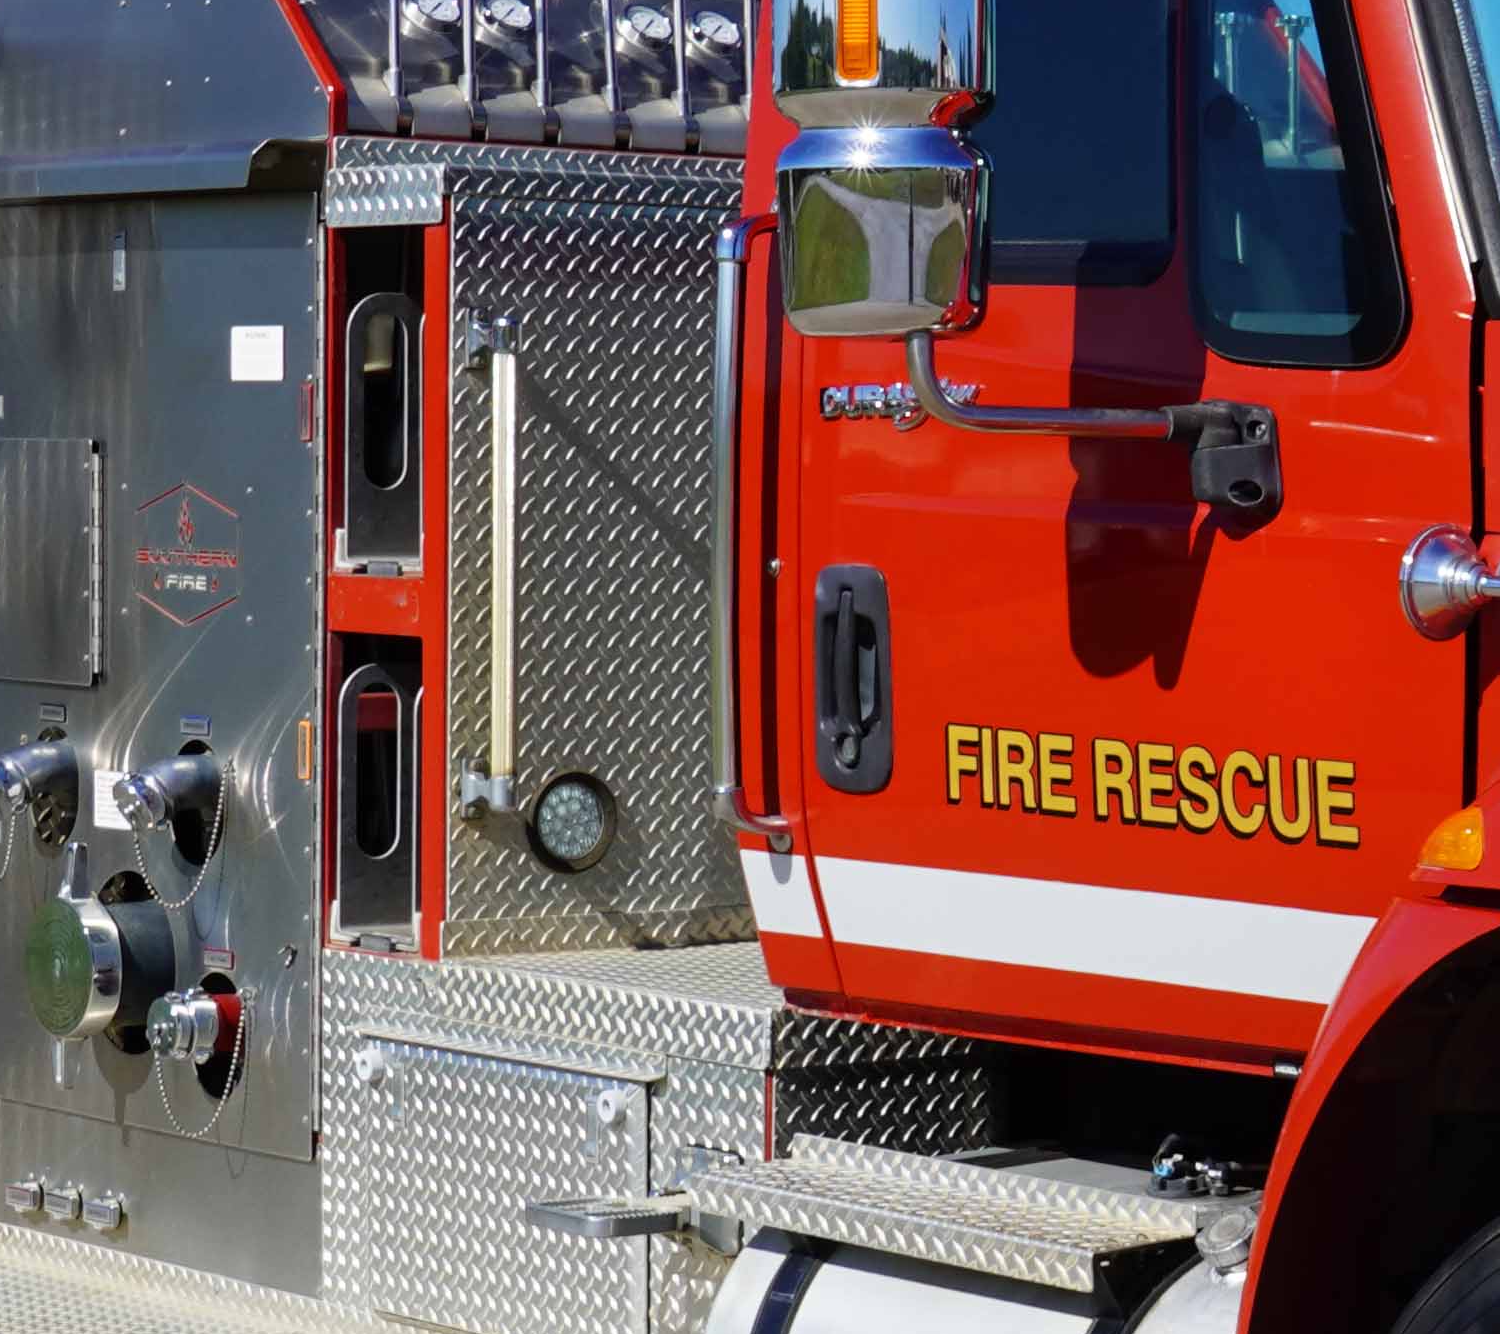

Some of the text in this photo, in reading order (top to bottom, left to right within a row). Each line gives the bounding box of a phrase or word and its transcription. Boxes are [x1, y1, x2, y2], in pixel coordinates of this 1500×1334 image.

[135, 547, 238, 568] SOUTHERN
[165, 573, 208, 592] FIRE
[945, 722, 1361, 850] FIRE RESCUE
